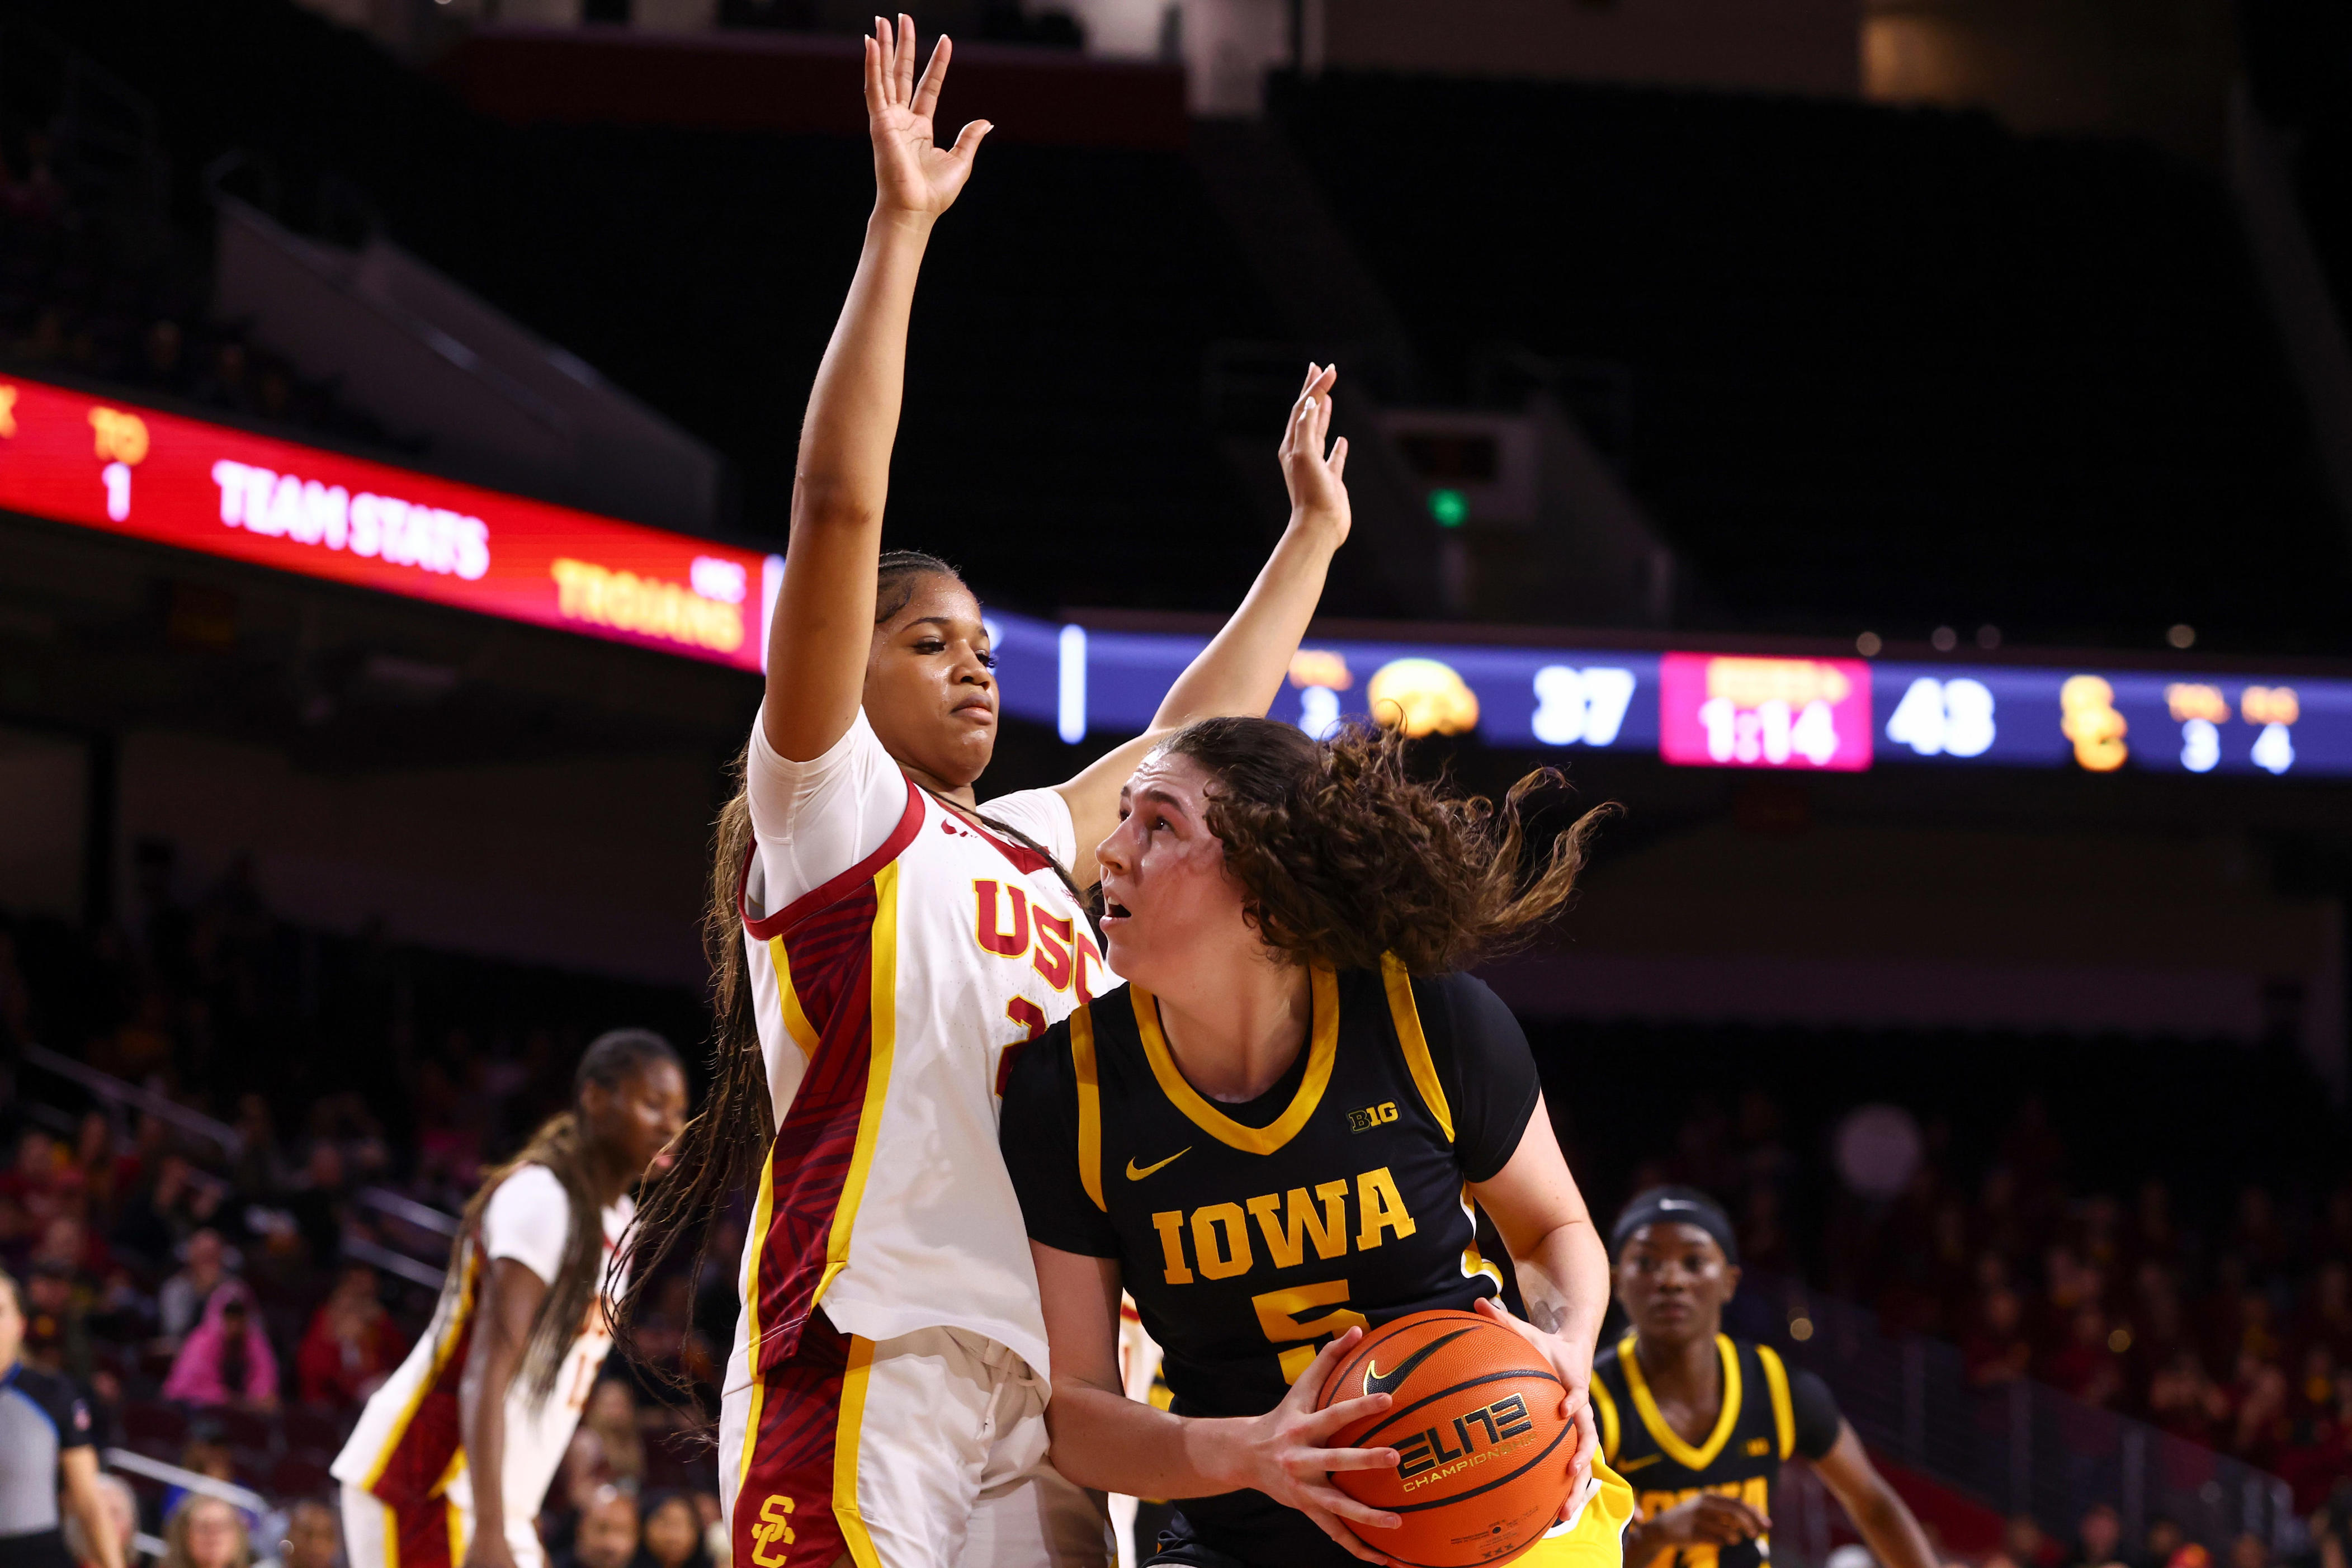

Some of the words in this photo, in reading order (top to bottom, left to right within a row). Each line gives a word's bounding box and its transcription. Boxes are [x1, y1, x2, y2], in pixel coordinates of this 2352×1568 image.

[102, 462, 131, 522] 1
[212, 460, 349, 550] TEAM
[349, 492, 489, 580] STATS
[1532, 665, 1636, 747] 37
[1698, 697, 1840, 766] 1:14
[1152, 1166, 1416, 1284] IOWA
[1251, 1279, 1371, 1387] 5
[1388, 1392, 1533, 1481] ELITE
[1402, 1433, 1538, 1493] CHAMPIONSHIP
